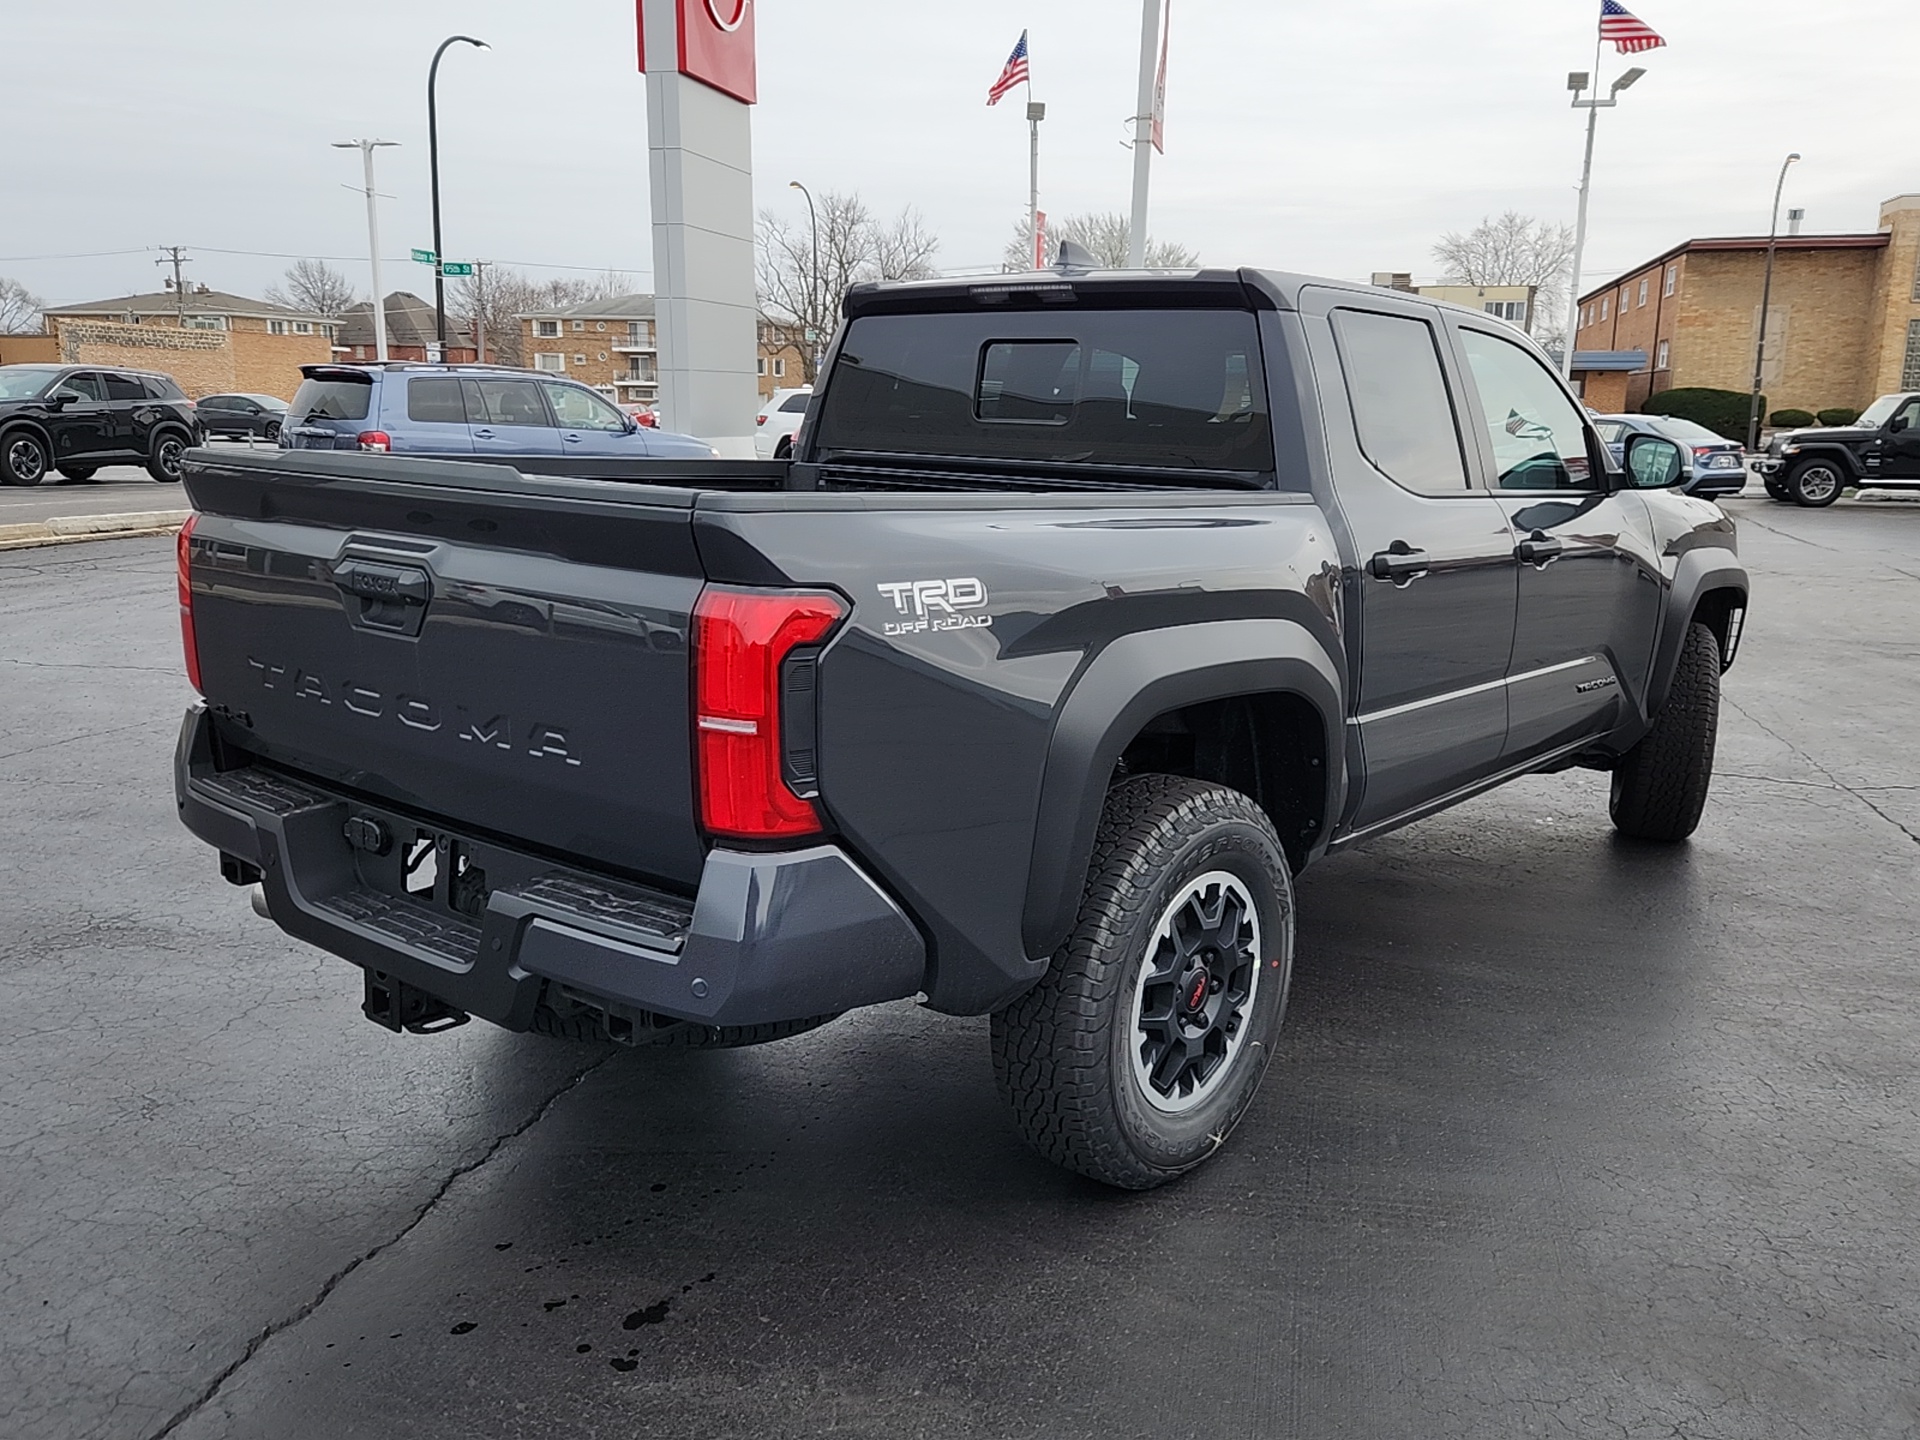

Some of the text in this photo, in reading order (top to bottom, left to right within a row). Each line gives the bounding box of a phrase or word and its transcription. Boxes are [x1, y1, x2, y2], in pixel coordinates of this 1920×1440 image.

[462, 264, 471, 273] St
[355, 573, 400, 597] TOYOTA
[876, 577, 989, 620] TRD
[883, 614, 993, 636] OFF ROAD
[247, 655, 582, 766] TACOMA
